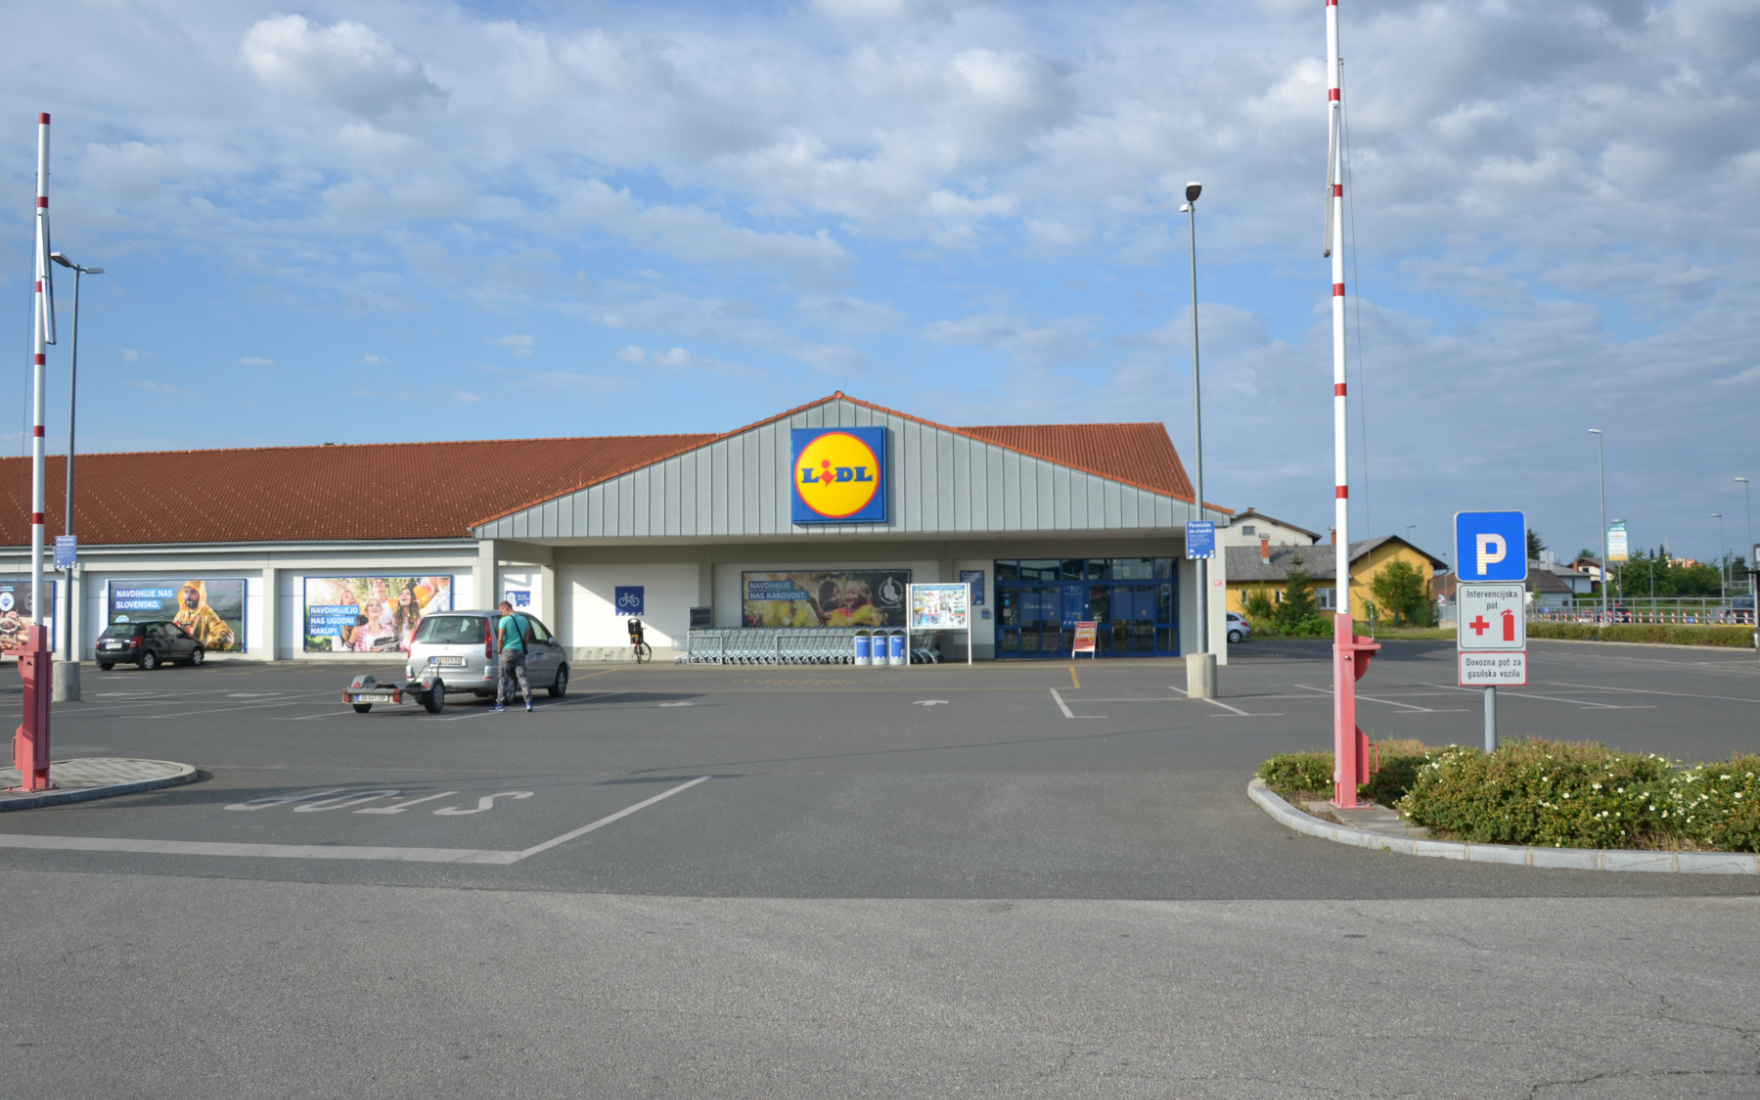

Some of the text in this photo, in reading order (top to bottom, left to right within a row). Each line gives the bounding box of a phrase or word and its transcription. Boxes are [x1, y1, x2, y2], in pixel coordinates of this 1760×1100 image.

[1476, 533, 1507, 575] P
[116, 589, 173, 598] NAVDIHUJE NAS
[767, 591, 807, 599] KAKOVOST.
[1466, 589, 1518, 599] Intervencijska
[116, 600, 160, 609] SLOVENSKO.
[1486, 601, 1499, 610] pot
[310, 606, 358, 614] NAVDIHUJEJO
[310, 627, 340, 635] NAKUPI.
[1466, 658, 1496, 667] Dovozna
[1498, 658, 1510, 669] pot
[1467, 669, 1520, 679] gasilska vozila
[223, 788, 535, 816] STOP
